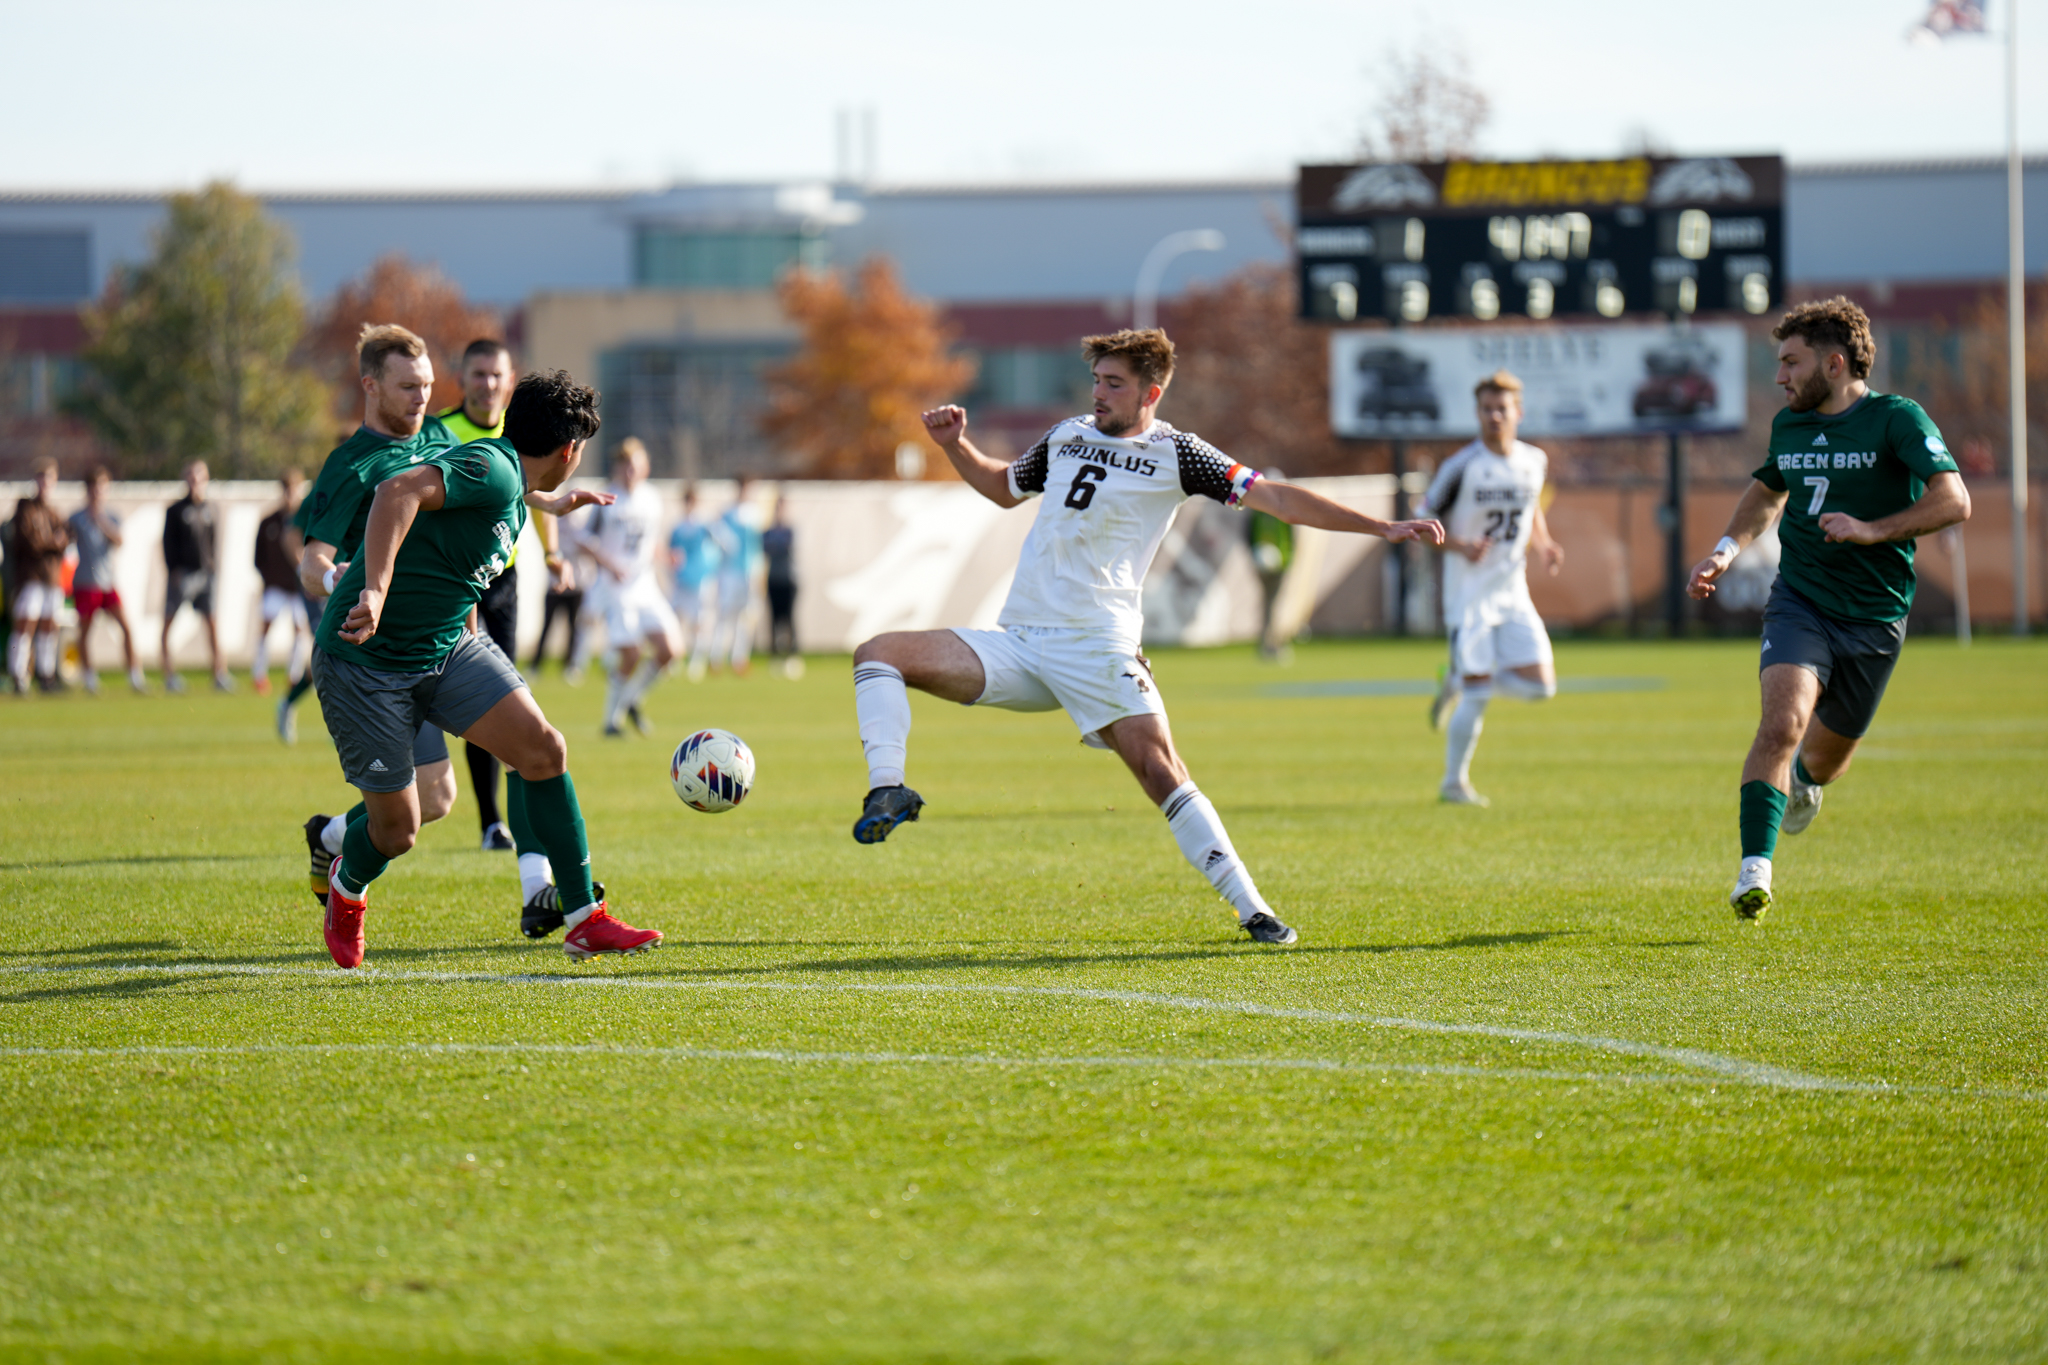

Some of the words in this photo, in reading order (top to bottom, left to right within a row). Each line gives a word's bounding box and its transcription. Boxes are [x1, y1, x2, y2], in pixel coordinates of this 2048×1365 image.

[1404, 217, 1425, 262] 1
[1777, 453, 1829, 471] GREEN
[1833, 452, 1877, 469] BAY
[1064, 464, 1107, 510] 6
[1803, 476, 1830, 515] 7
